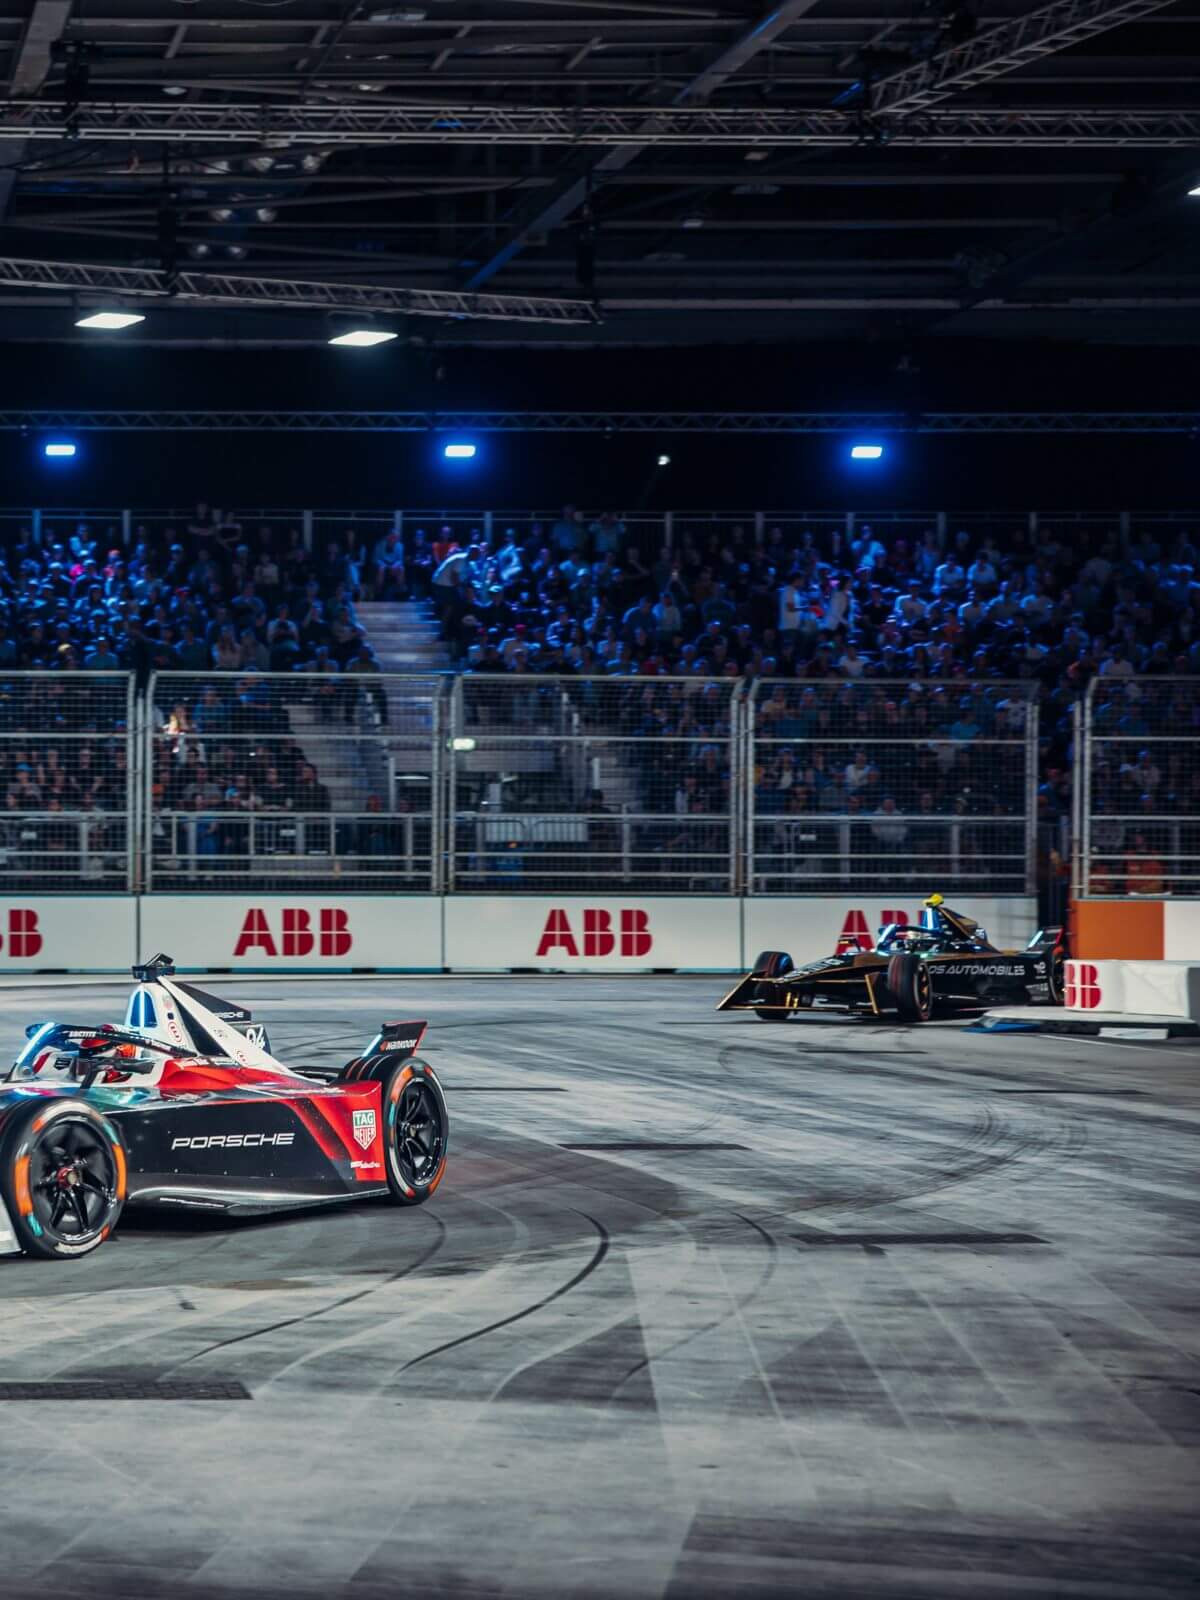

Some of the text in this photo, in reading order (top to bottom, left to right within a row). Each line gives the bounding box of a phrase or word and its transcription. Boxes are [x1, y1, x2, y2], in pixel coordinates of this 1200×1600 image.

[234, 908, 353, 957] ABB
[536, 908, 653, 957] ABB
[945, 964, 1026, 976] AUTOMOBILES
[355, 1112, 374, 1127] TAG
[171, 1132, 296, 1150] PORSCHE
